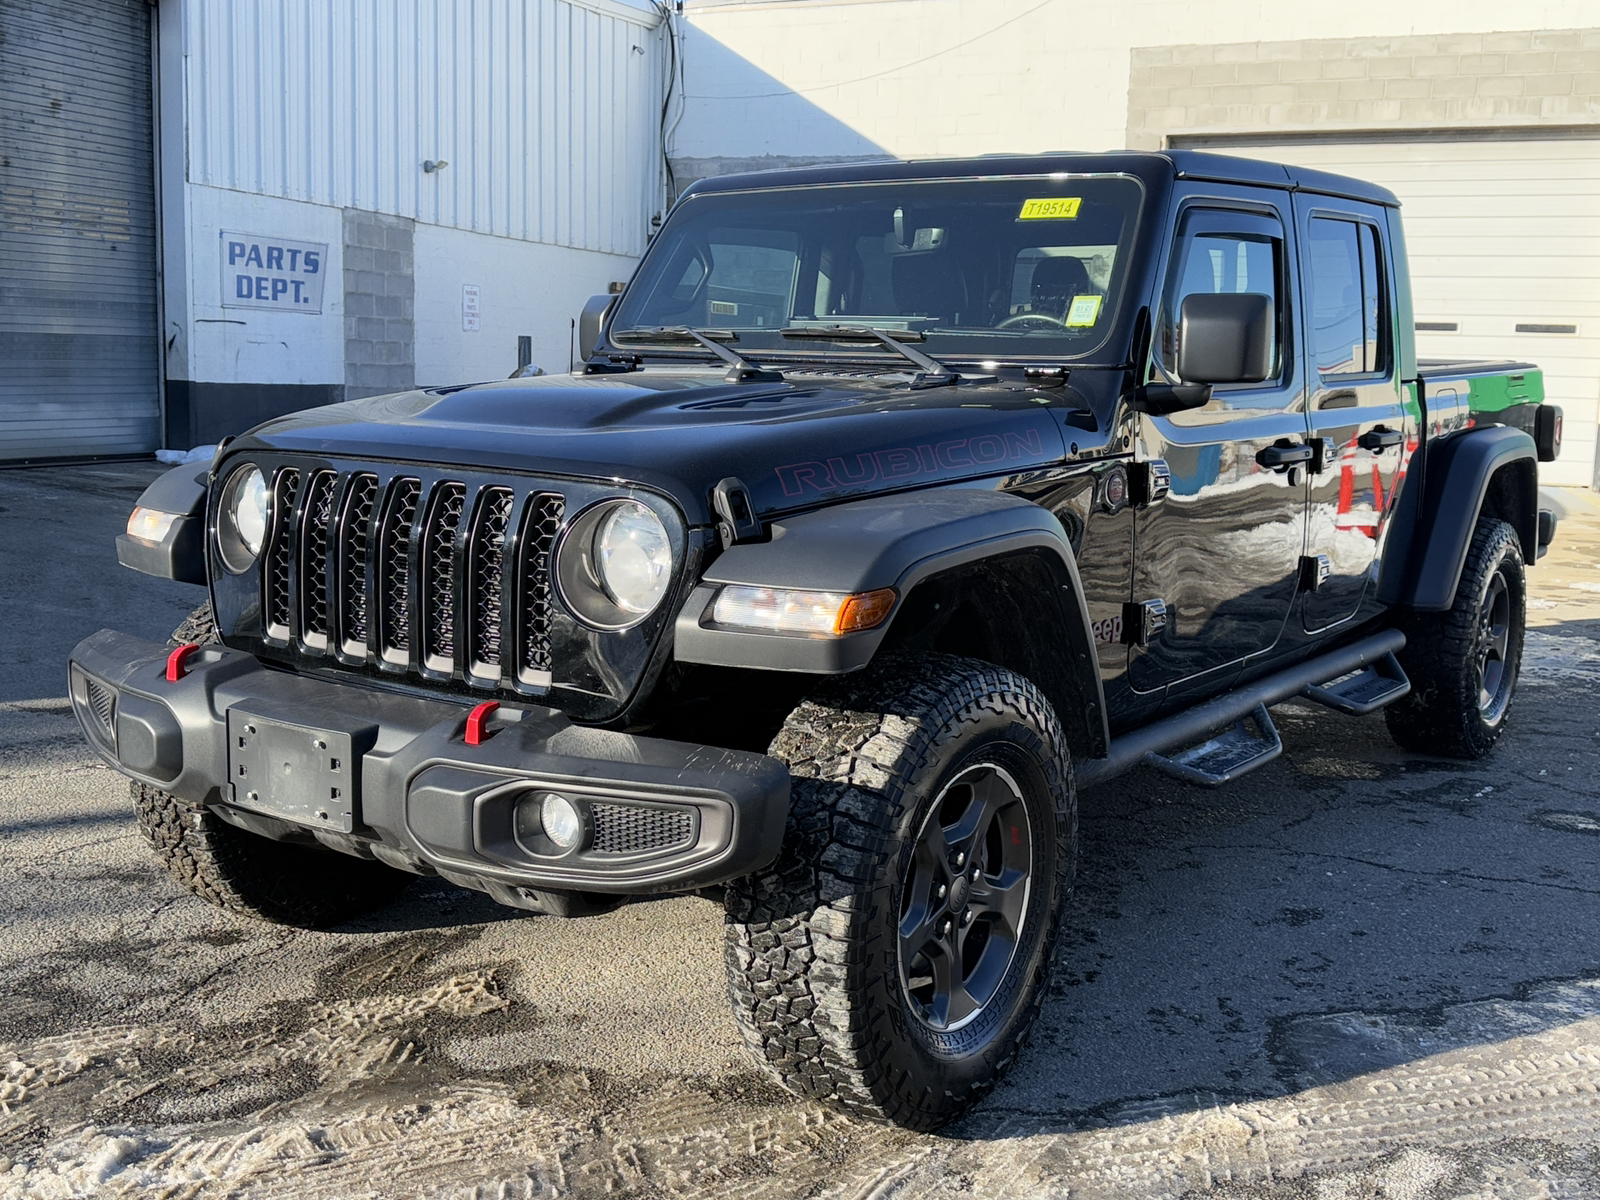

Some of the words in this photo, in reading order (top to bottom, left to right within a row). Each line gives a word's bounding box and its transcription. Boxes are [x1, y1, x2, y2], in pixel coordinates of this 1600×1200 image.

[1028, 202, 1073, 215] T19514
[228, 241, 320, 274] PARTS
[236, 274, 309, 304] DEPT.
[775, 429, 1043, 497] RUBICON
[1091, 616, 1123, 643] eep
